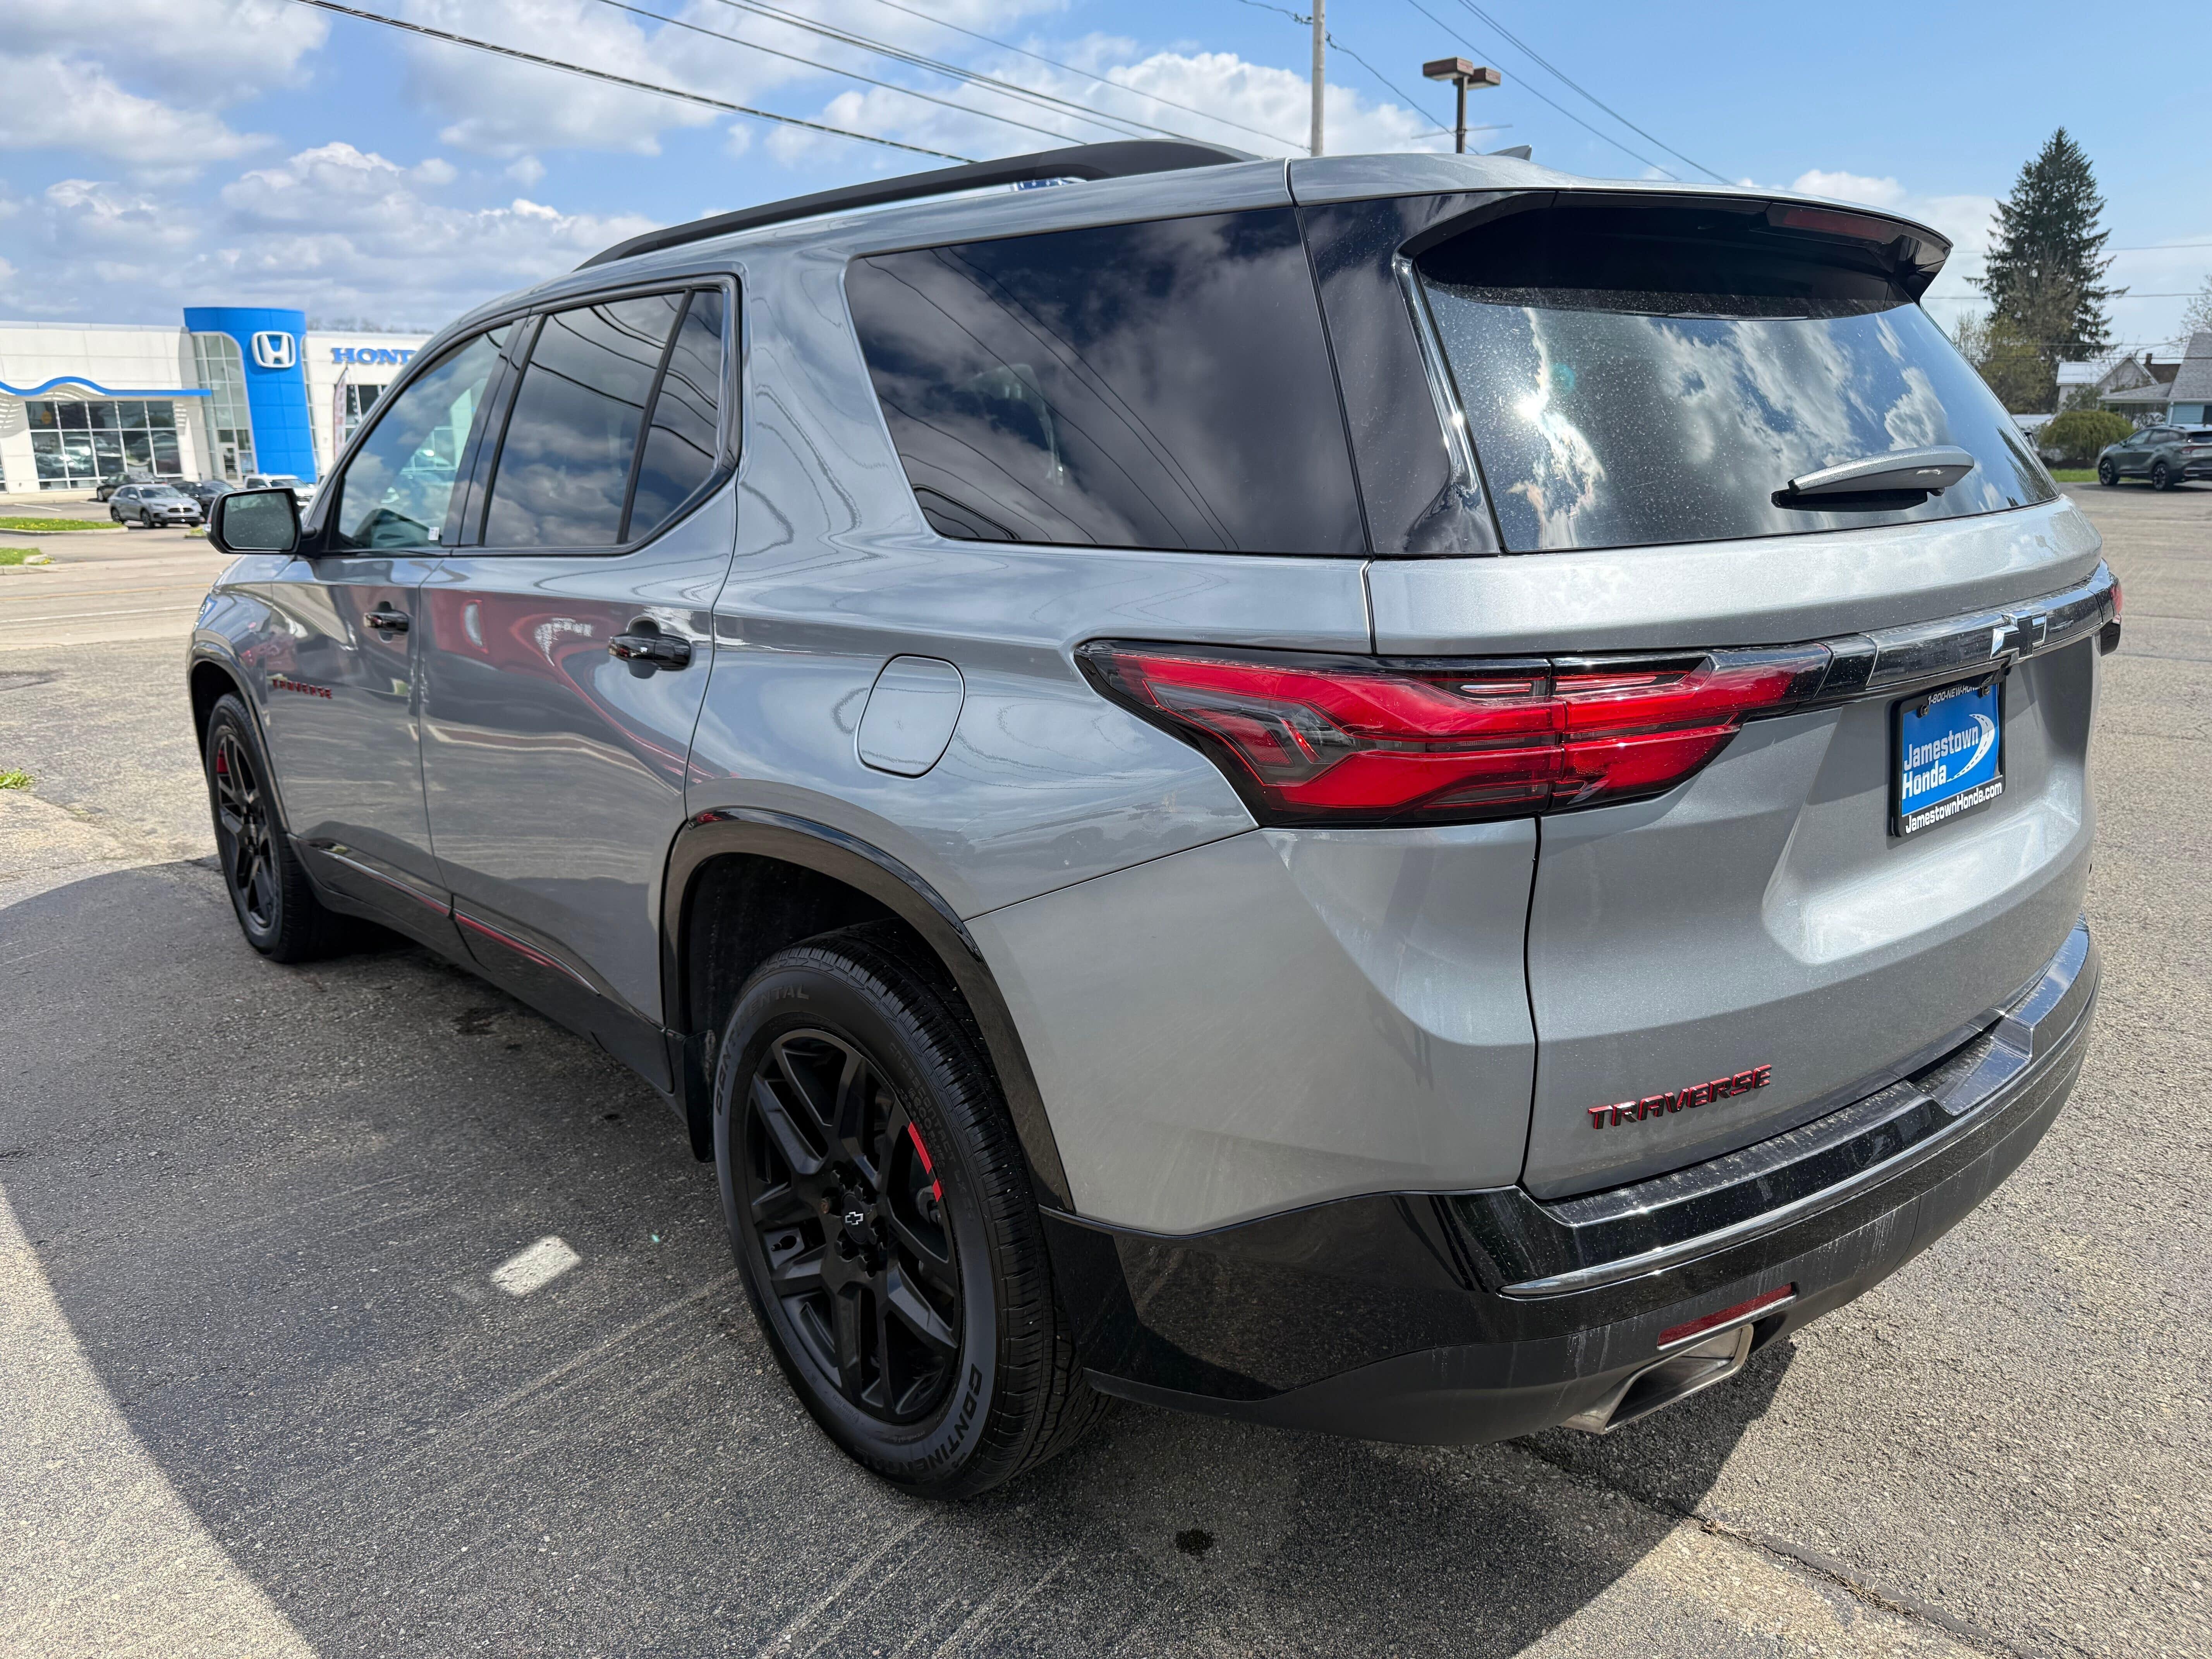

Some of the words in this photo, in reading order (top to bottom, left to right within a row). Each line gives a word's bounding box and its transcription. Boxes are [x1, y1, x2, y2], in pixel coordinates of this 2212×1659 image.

[331, 347, 417, 364] HOND
[1928, 685, 1982, 705] 1-800-NEW-HO
[1903, 726, 1979, 771] Jamestown
[1902, 761, 1946, 799] Honda
[1905, 782, 2002, 833] JamestownHonda.com
[1587, 1064, 1772, 1130] TRAVERSE
[854, 1363, 983, 1474] CONTINENTAL
